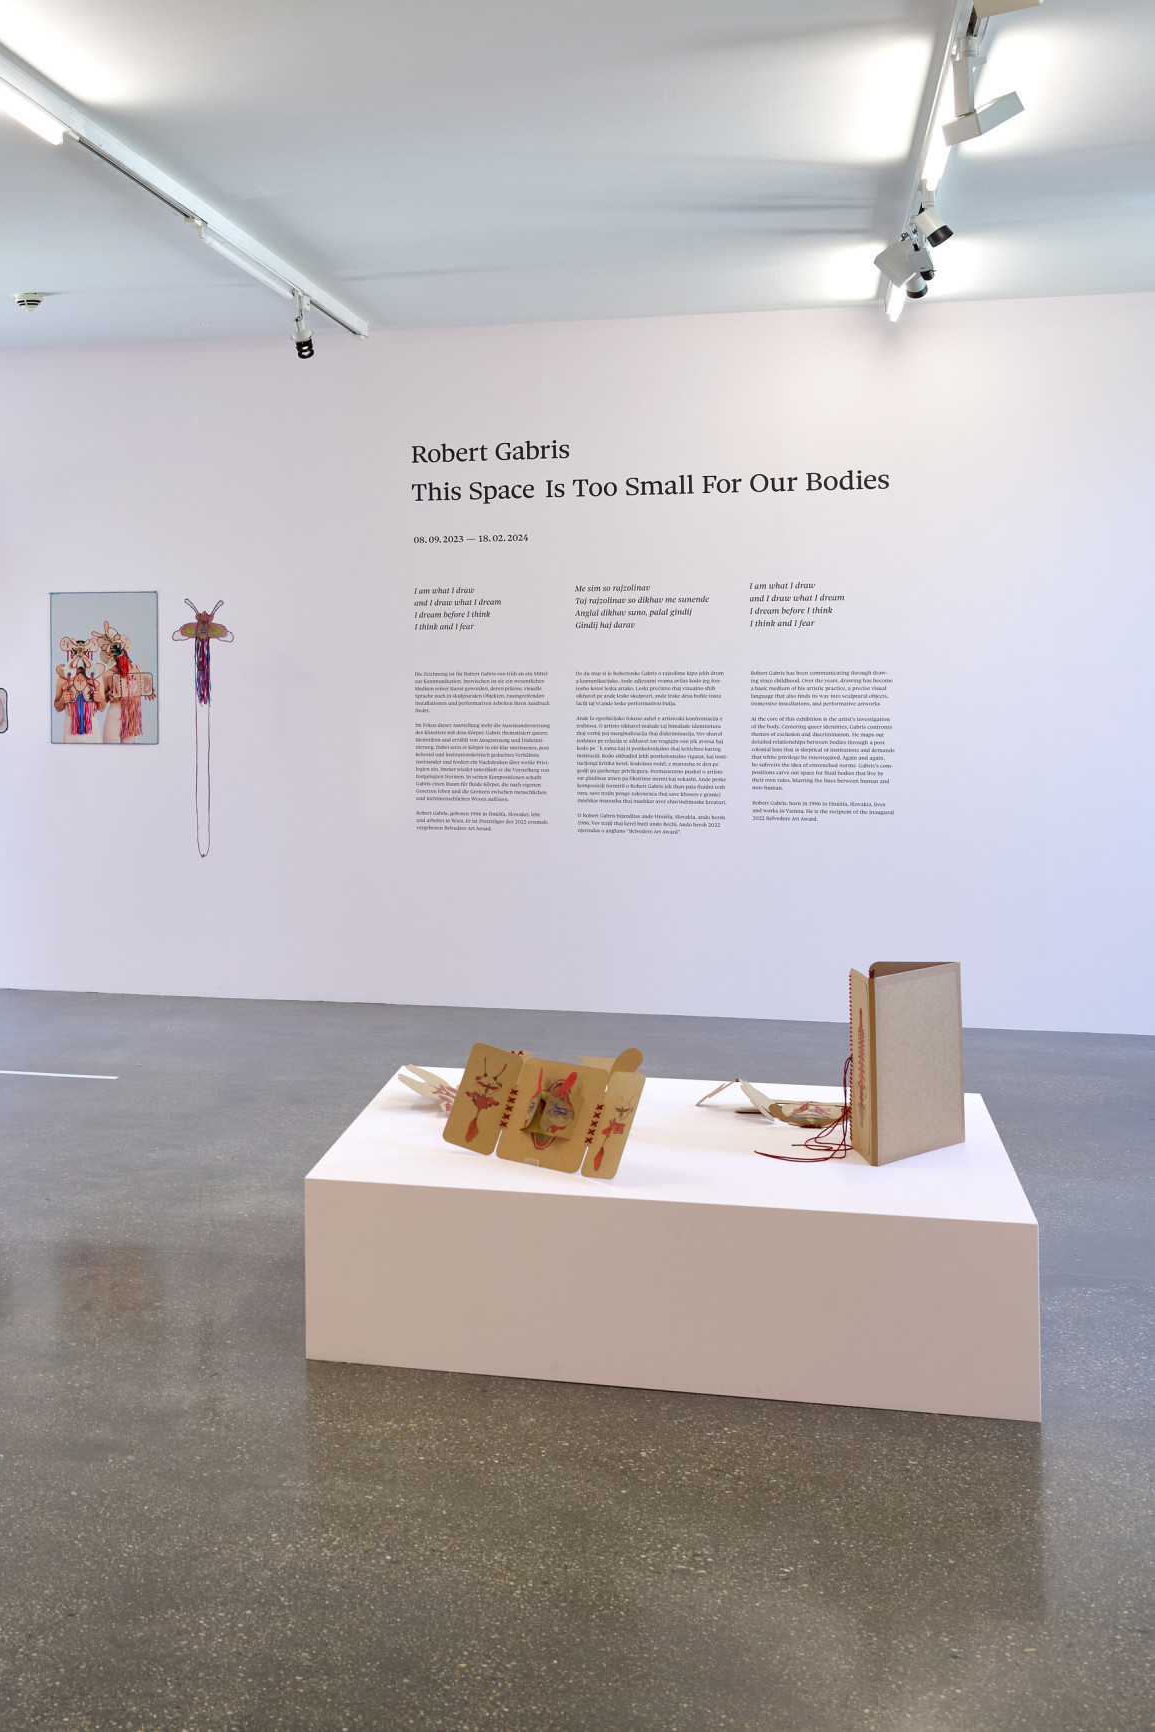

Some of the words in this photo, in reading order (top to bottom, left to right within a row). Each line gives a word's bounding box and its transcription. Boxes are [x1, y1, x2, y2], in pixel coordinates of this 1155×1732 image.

[412, 444, 487, 463] Robert
[495, 440, 569, 460] Gabris
[412, 482, 461, 501] This
[470, 482, 534, 504] Space
[546, 480, 565, 497] Is
[573, 479, 617, 497] Too
[626, 475, 694, 496] Small
[702, 476, 742, 493] For
[750, 474, 798, 492] Our
[806, 470, 889, 491] Bodies
[575, 597, 587, 606] Taj
[443, 610, 465, 619] before
[781, 607, 805, 616] before
[460, 622, 474, 631] fear
[600, 622, 612, 630] haj
[799, 620, 814, 628] fear
